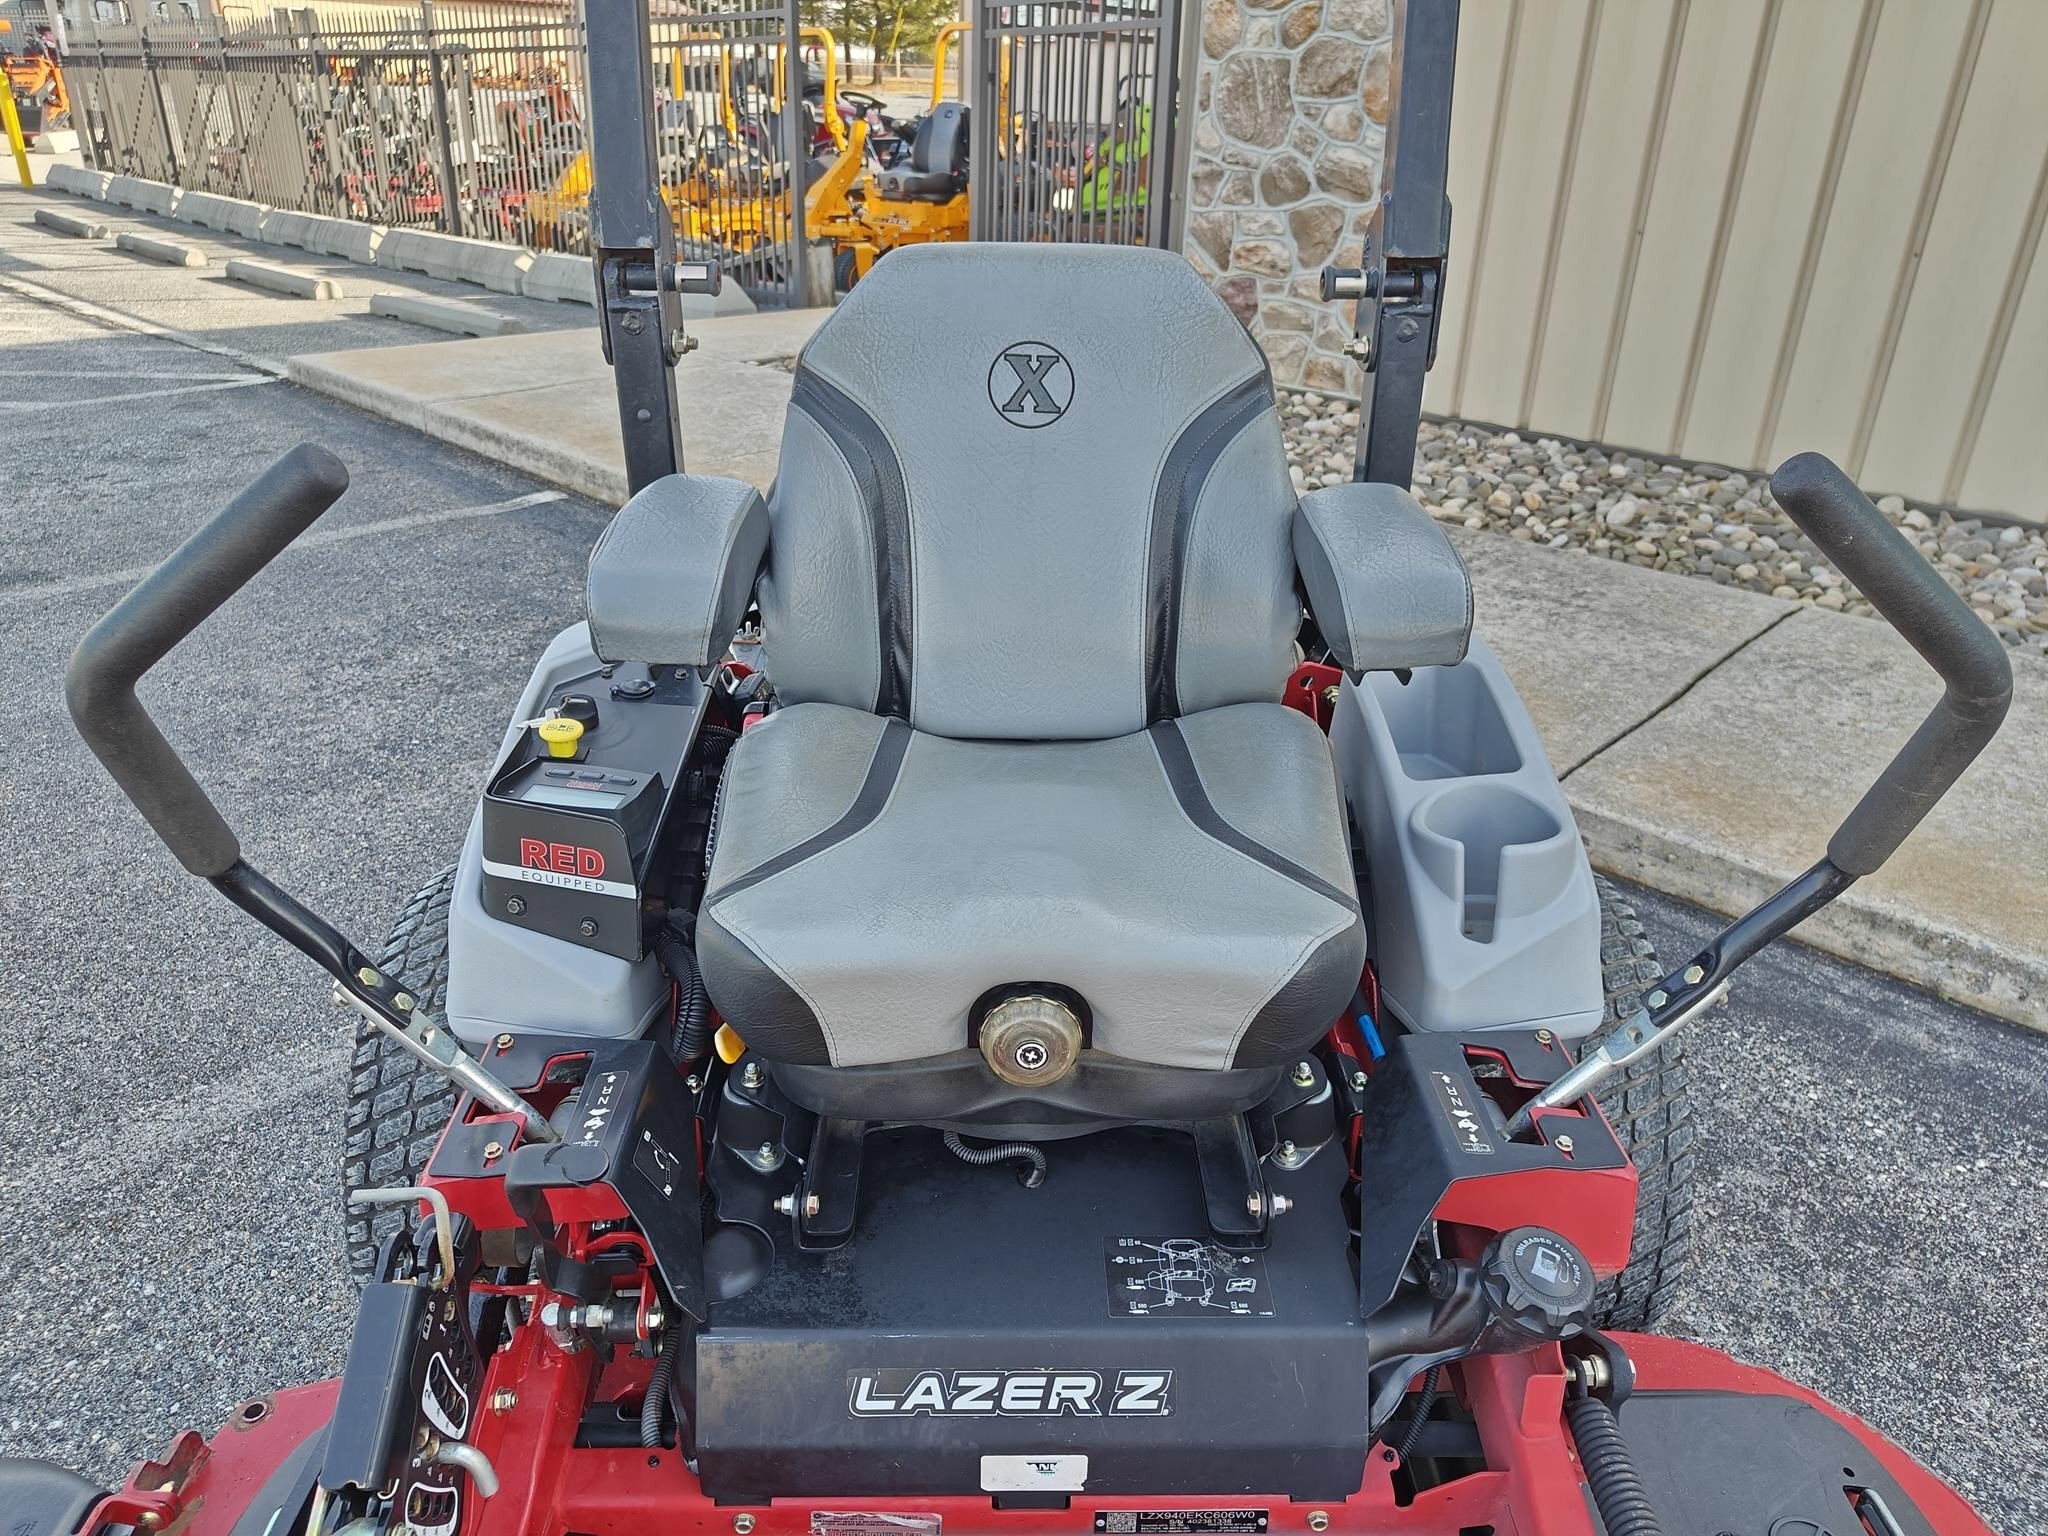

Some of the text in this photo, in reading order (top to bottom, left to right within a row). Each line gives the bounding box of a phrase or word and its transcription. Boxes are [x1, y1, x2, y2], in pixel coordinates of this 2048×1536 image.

[1002, 353, 1061, 414] X
[520, 838, 605, 878] RED
[521, 870, 605, 892] EQUIPPED
[1515, 1237, 1581, 1287] UNLEADED FUEL ONLY
[850, 1373, 1170, 1413] LAZER Z
[1140, 1511, 1255, 1520] LZX940EKC606W0
